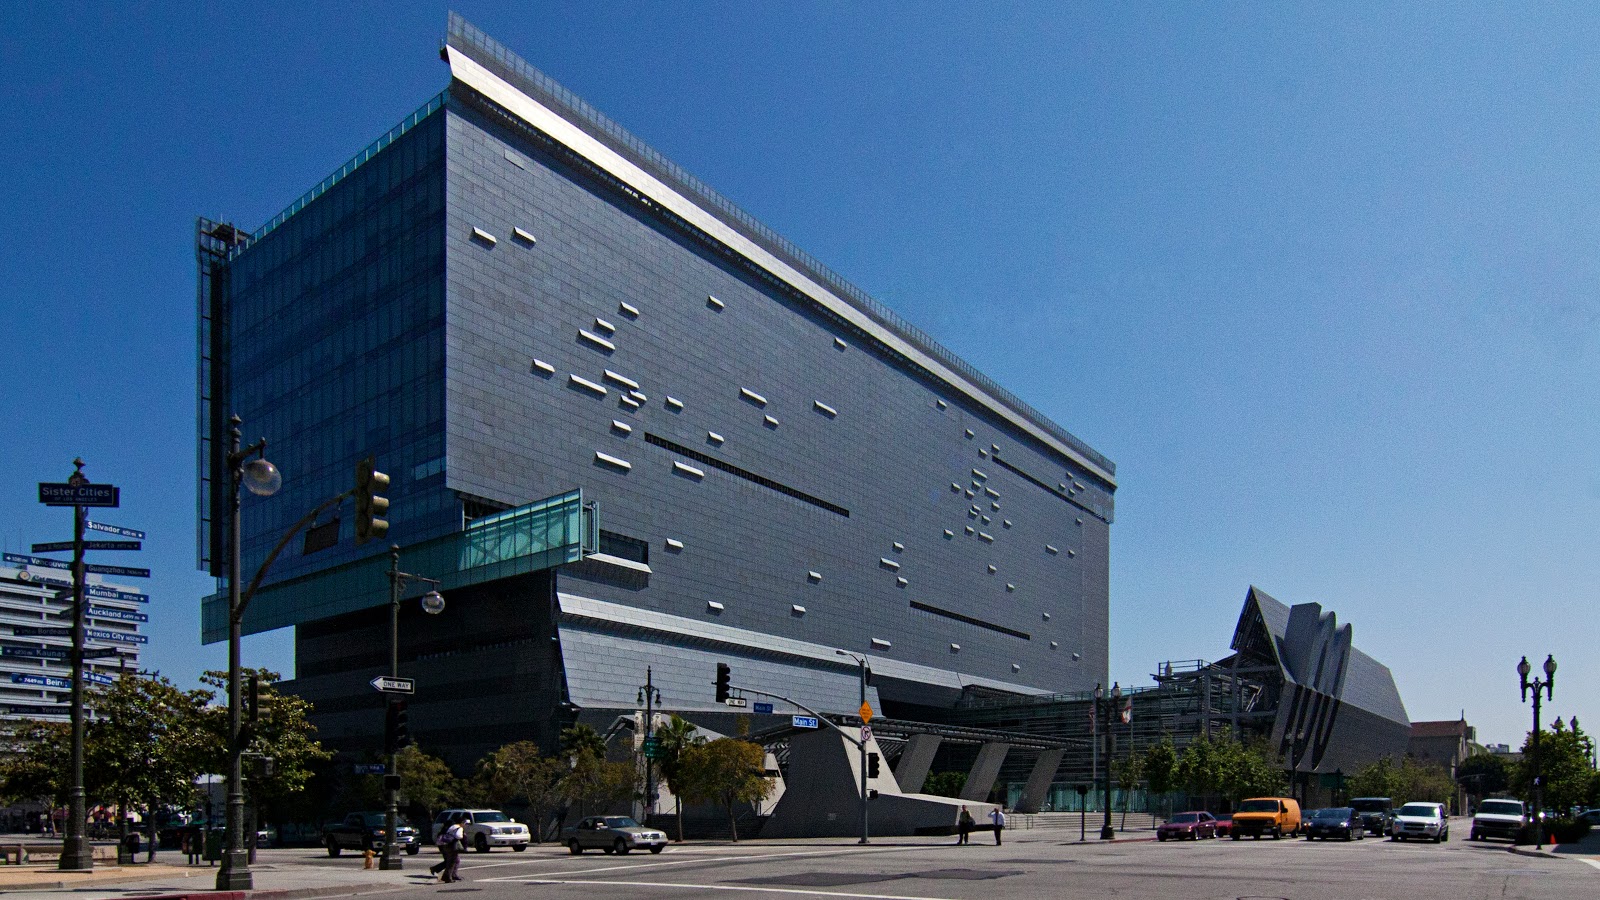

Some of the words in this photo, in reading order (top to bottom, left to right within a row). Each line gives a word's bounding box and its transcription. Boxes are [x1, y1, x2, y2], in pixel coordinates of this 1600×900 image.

[42, 487, 74, 496] Sister
[79, 487, 110, 497] Cities
[87, 521, 120, 534] Salvador
[31, 557, 69, 569] Vancouver
[88, 564, 125, 574] Guangzhou
[89, 589, 119, 598] Mumbai
[88, 608, 122, 618] Auckland
[87, 629, 110, 638] Mexico
[111, 632, 125, 641] City
[36, 649, 66, 657] Kaunas
[794, 717, 808, 726] Main
[808, 719, 816, 727] St
